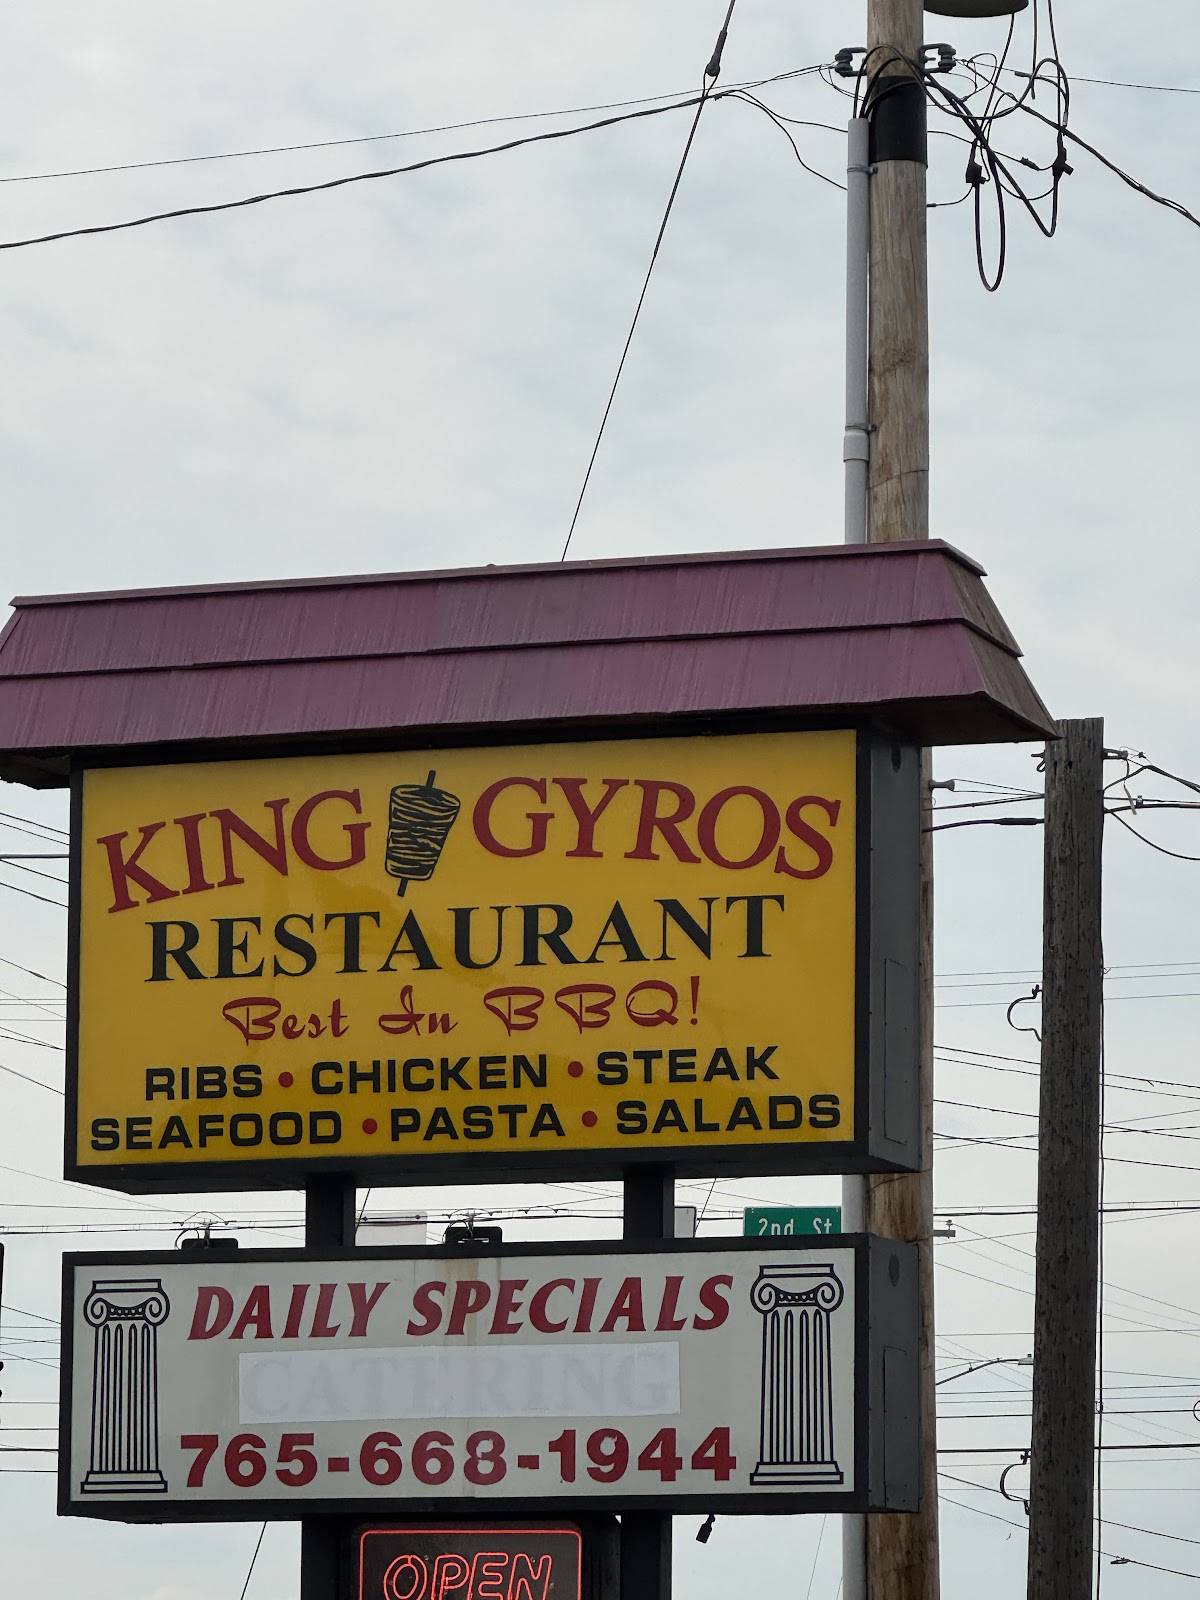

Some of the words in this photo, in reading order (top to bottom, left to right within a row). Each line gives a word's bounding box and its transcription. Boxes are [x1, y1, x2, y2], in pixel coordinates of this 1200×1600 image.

[97, 789, 371, 913] KING
[472, 777, 842, 880] GYROS
[145, 895, 784, 982] RESTAURANT
[222, 997, 350, 1045] Best
[378, 985, 458, 1036] In
[483, 976, 701, 1036] BBQ!
[146, 1064, 262, 1101] RIBS
[312, 1054, 548, 1096] CHICKEN
[597, 1046, 779, 1086] STEAK
[91, 1111, 341, 1152] SEAFOOD
[391, 1104, 566, 1142] PASTA
[617, 1094, 841, 1134] SALADS
[758, 1218, 794, 1236] 2nd
[812, 1217, 833, 1234] St
[187, 1281, 389, 1340] DAILY
[406, 1275, 733, 1336] SPECIALS
[242, 1351, 669, 1417] CATERING
[181, 1428, 737, 1488] 765-668-1944
[383, 1552, 553, 1600] OPEN
